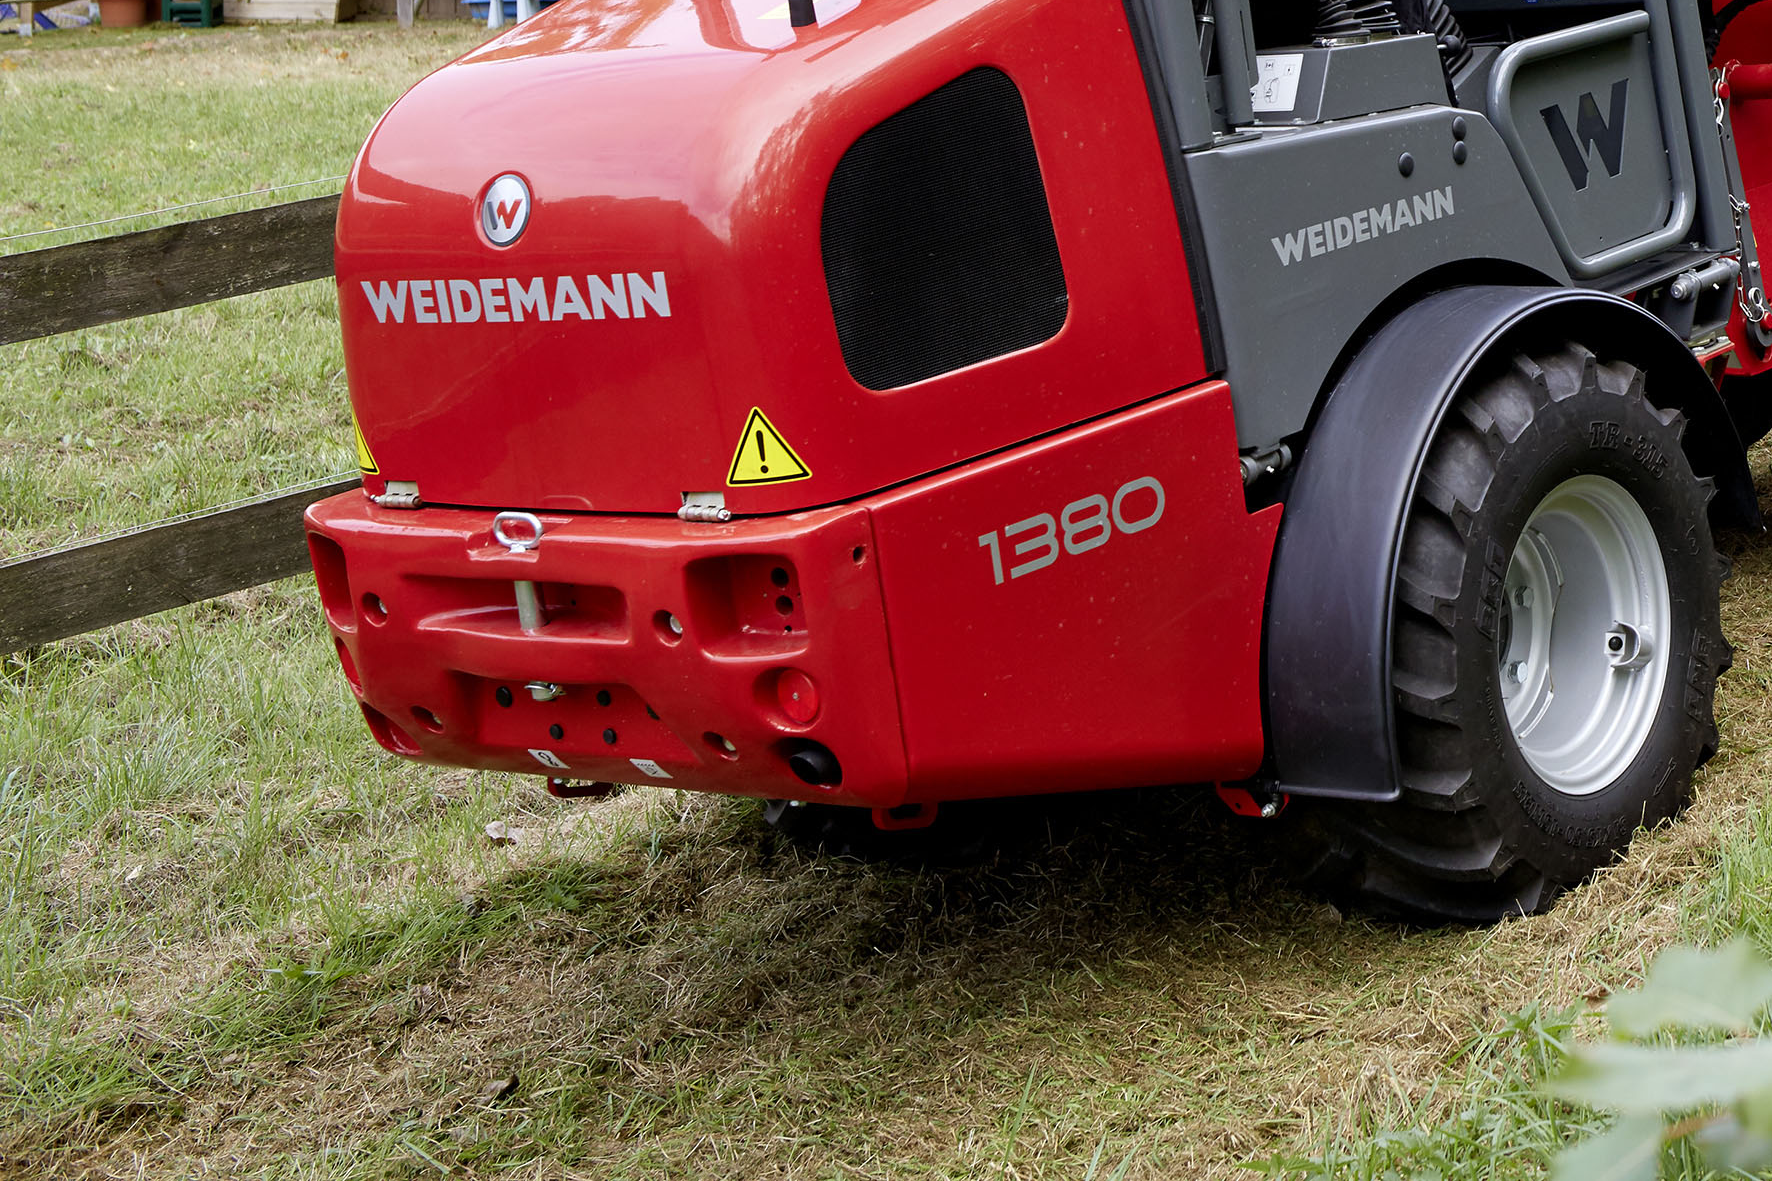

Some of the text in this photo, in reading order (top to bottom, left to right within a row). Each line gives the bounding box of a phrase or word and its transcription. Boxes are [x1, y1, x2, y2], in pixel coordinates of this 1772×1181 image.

[1540, 78, 1629, 192] W
[487, 199, 523, 230] W
[1271, 185, 1455, 267] WEIDEMANN
[360, 271, 672, 324] WEIDEMANN
[978, 476, 1166, 586] 1380
